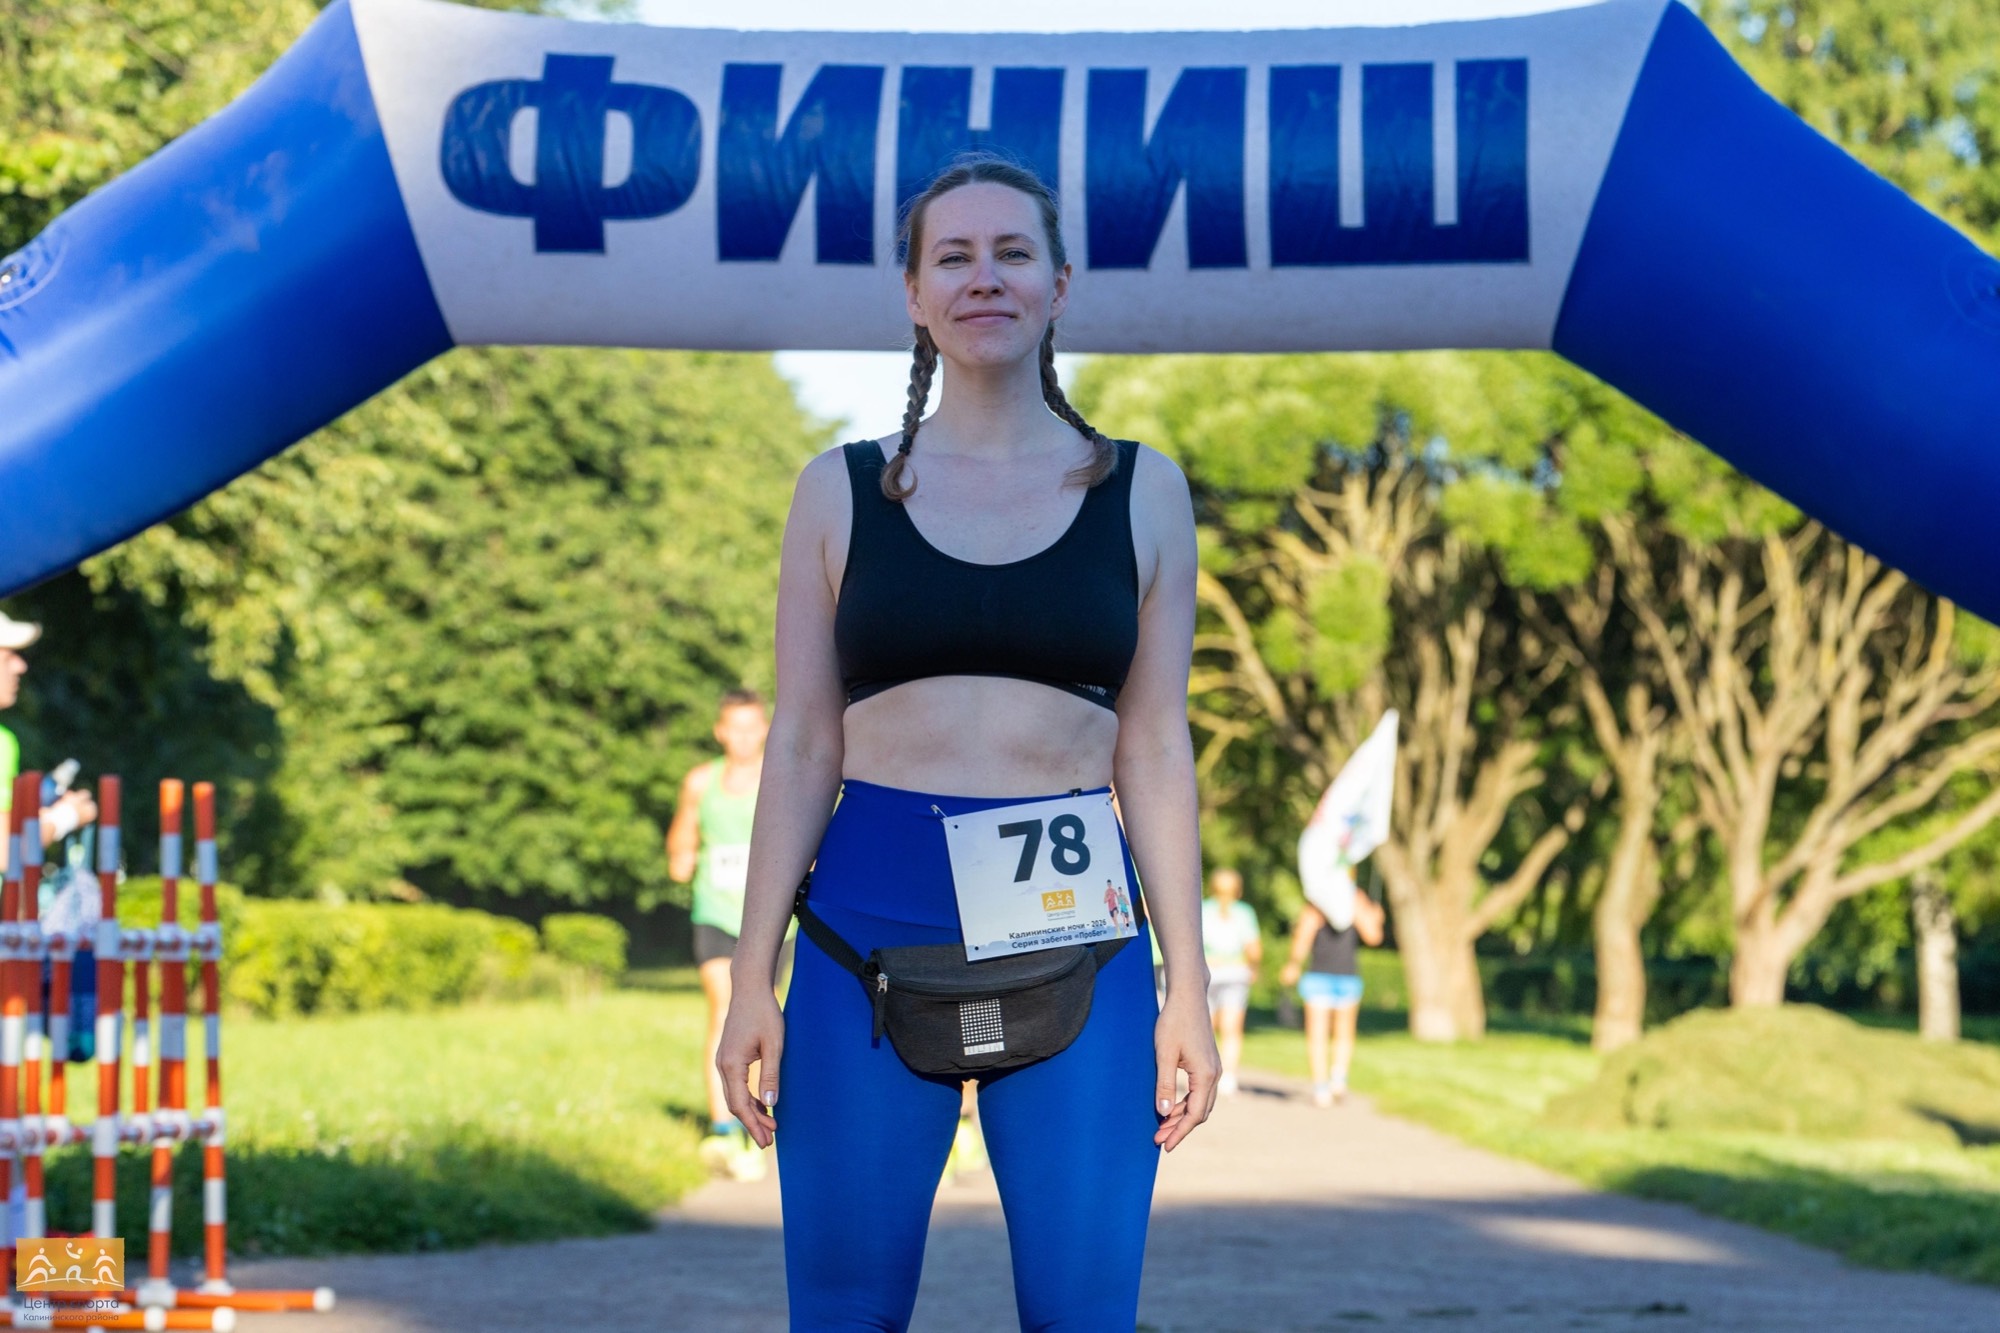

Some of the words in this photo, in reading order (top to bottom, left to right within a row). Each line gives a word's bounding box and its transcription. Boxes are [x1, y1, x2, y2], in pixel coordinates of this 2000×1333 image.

[440, 53, 1530, 269] ФИНИШ
[997, 813, 1090, 882] 78
[1009, 927, 1066, 939] Калининские
[1067, 923, 1085, 931] ночи
[1012, 940, 1039, 949] Серия
[1041, 935, 1073, 944] забегов
